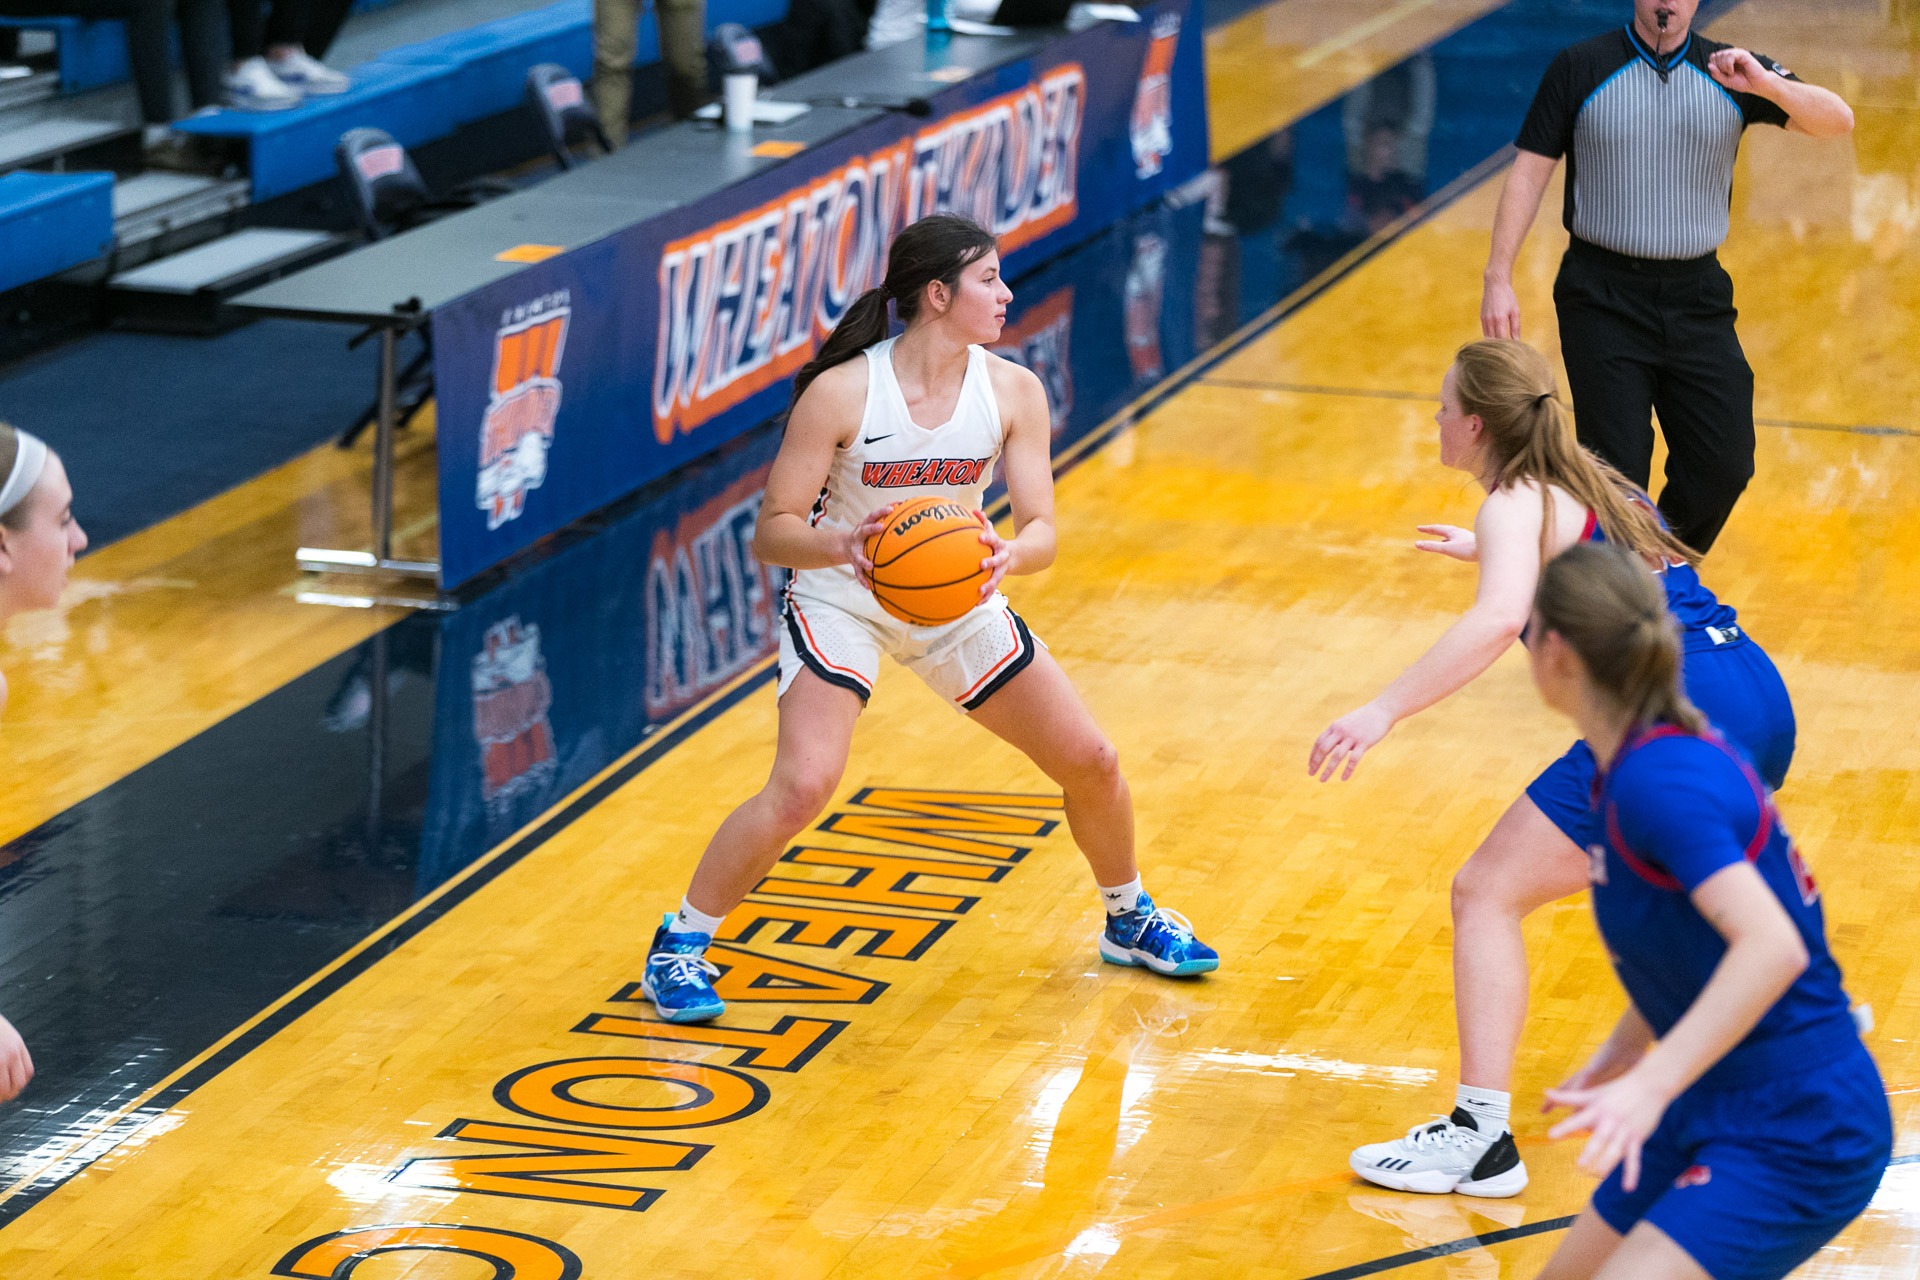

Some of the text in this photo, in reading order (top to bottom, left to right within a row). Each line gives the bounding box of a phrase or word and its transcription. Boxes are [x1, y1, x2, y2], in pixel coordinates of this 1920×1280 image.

[652, 144, 910, 428] WHEATON
[861, 457, 992, 488] WHEATON
[893, 503, 973, 537] Wilson
[383, 786, 1064, 1212] WHEATON
